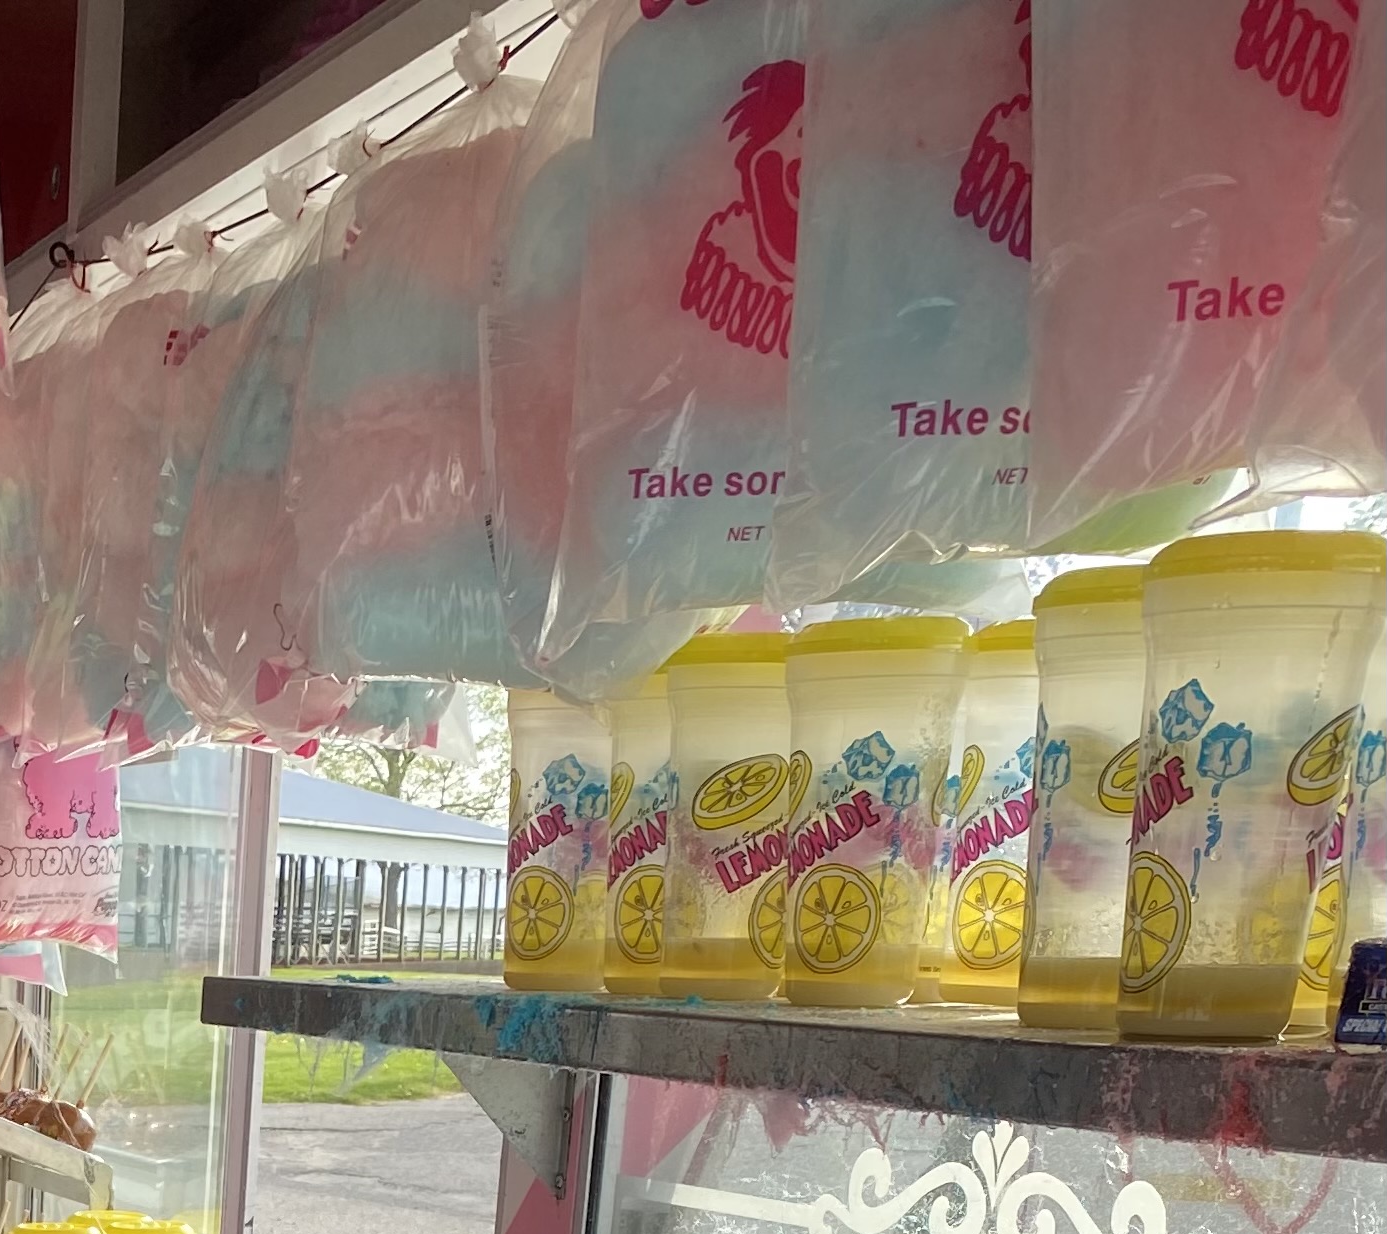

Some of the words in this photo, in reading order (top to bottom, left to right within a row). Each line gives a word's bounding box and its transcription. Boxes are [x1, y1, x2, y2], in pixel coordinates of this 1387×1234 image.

[1167, 276, 1285, 322] Take
[891, 399, 989, 438] Take
[628, 466, 713, 499] Take
[726, 525, 765, 542] NET
[832, 780, 856, 804] Cold
